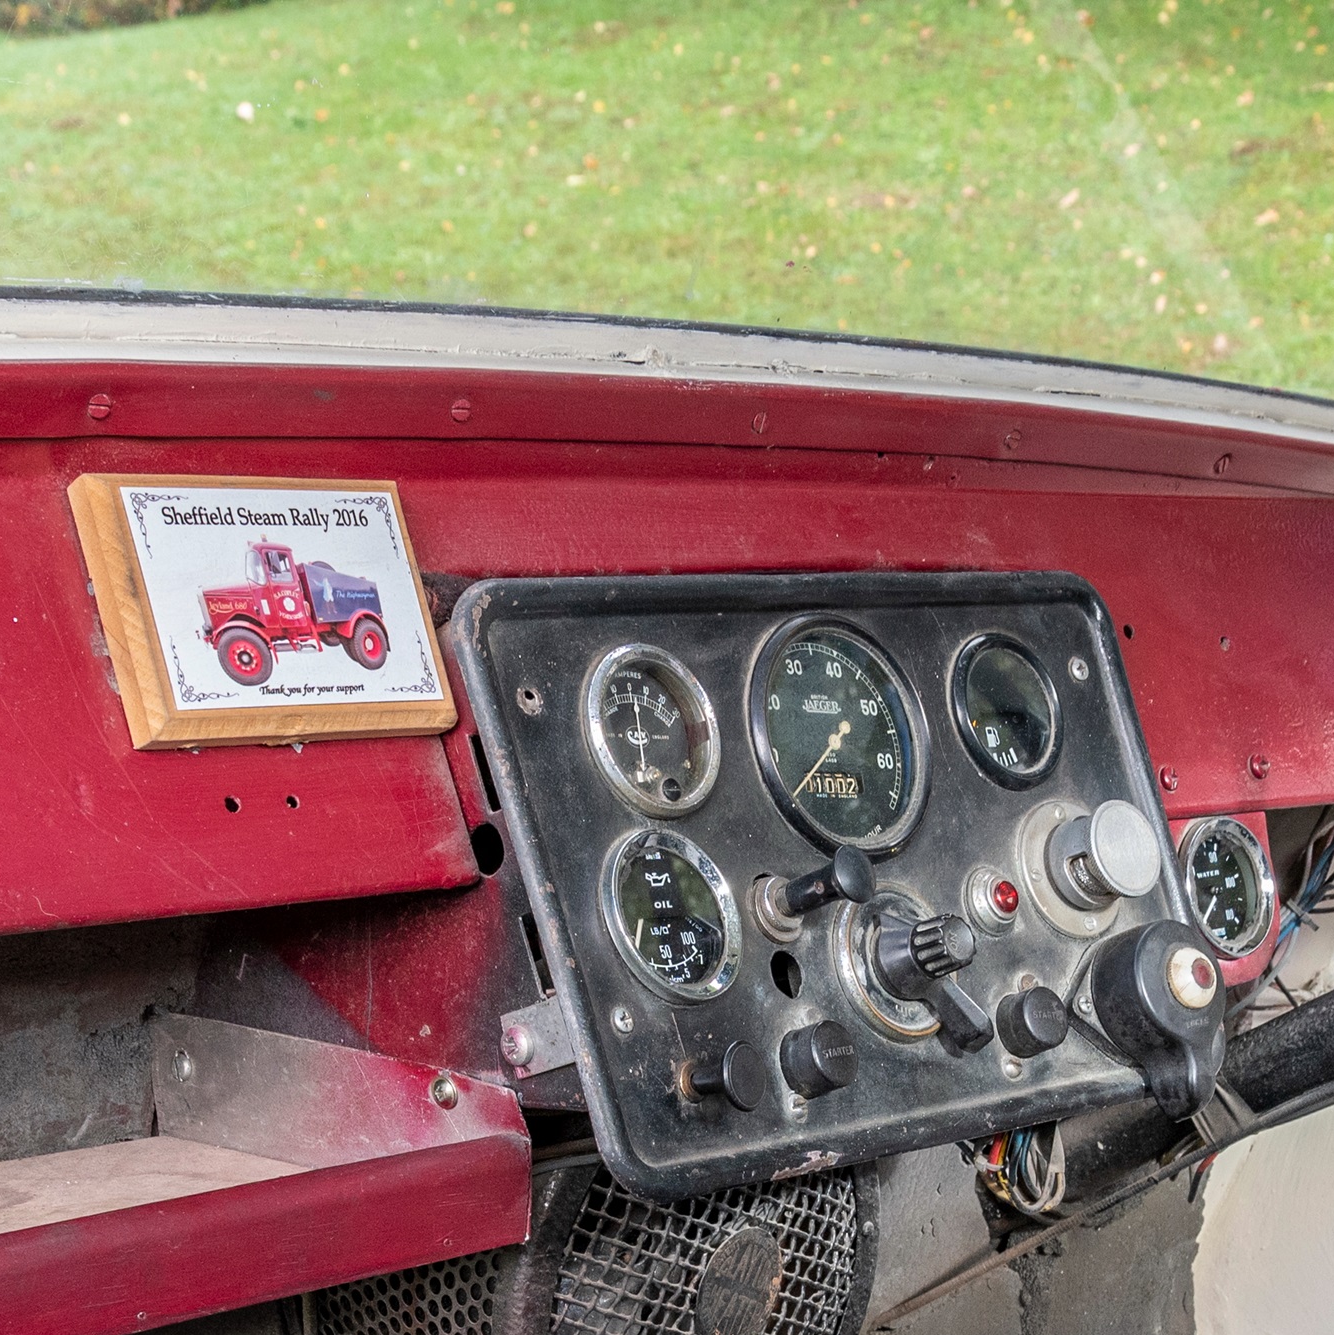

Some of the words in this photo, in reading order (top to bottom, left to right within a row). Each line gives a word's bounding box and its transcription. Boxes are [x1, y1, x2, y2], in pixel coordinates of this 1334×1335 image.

[161, 506, 236, 526] Sheffield
[237, 507, 288, 526] Steam
[288, 508, 329, 532] Rally
[333, 508, 369, 527] 2016
[785, 658, 803, 675] 30
[825, 661, 843, 678] 40
[614, 671, 642, 680] AMPERES
[259, 685, 287, 696] Thank
[286, 686, 302, 697] you
[302, 684, 316, 696] for
[317, 685, 335, 696] your
[336, 684, 364, 695] support
[642, 685, 650, 695] 10
[658, 694, 666, 704] 20
[672, 707, 681, 719] 30
[802, 699, 842, 714] JAEGER
[860, 699, 878, 716] 50
[877, 752, 894, 769] 60
[864, 824, 883, 839] OUR
[1196, 869, 1220, 879] WATER
[654, 900, 673, 909] OIL
[680, 931, 696, 945] 100
[659, 944, 673, 959] 50
[684, 967, 691, 978] 5
[895, 1004, 921, 1018] LUC
[822, 1045, 855, 1059] STARTER
